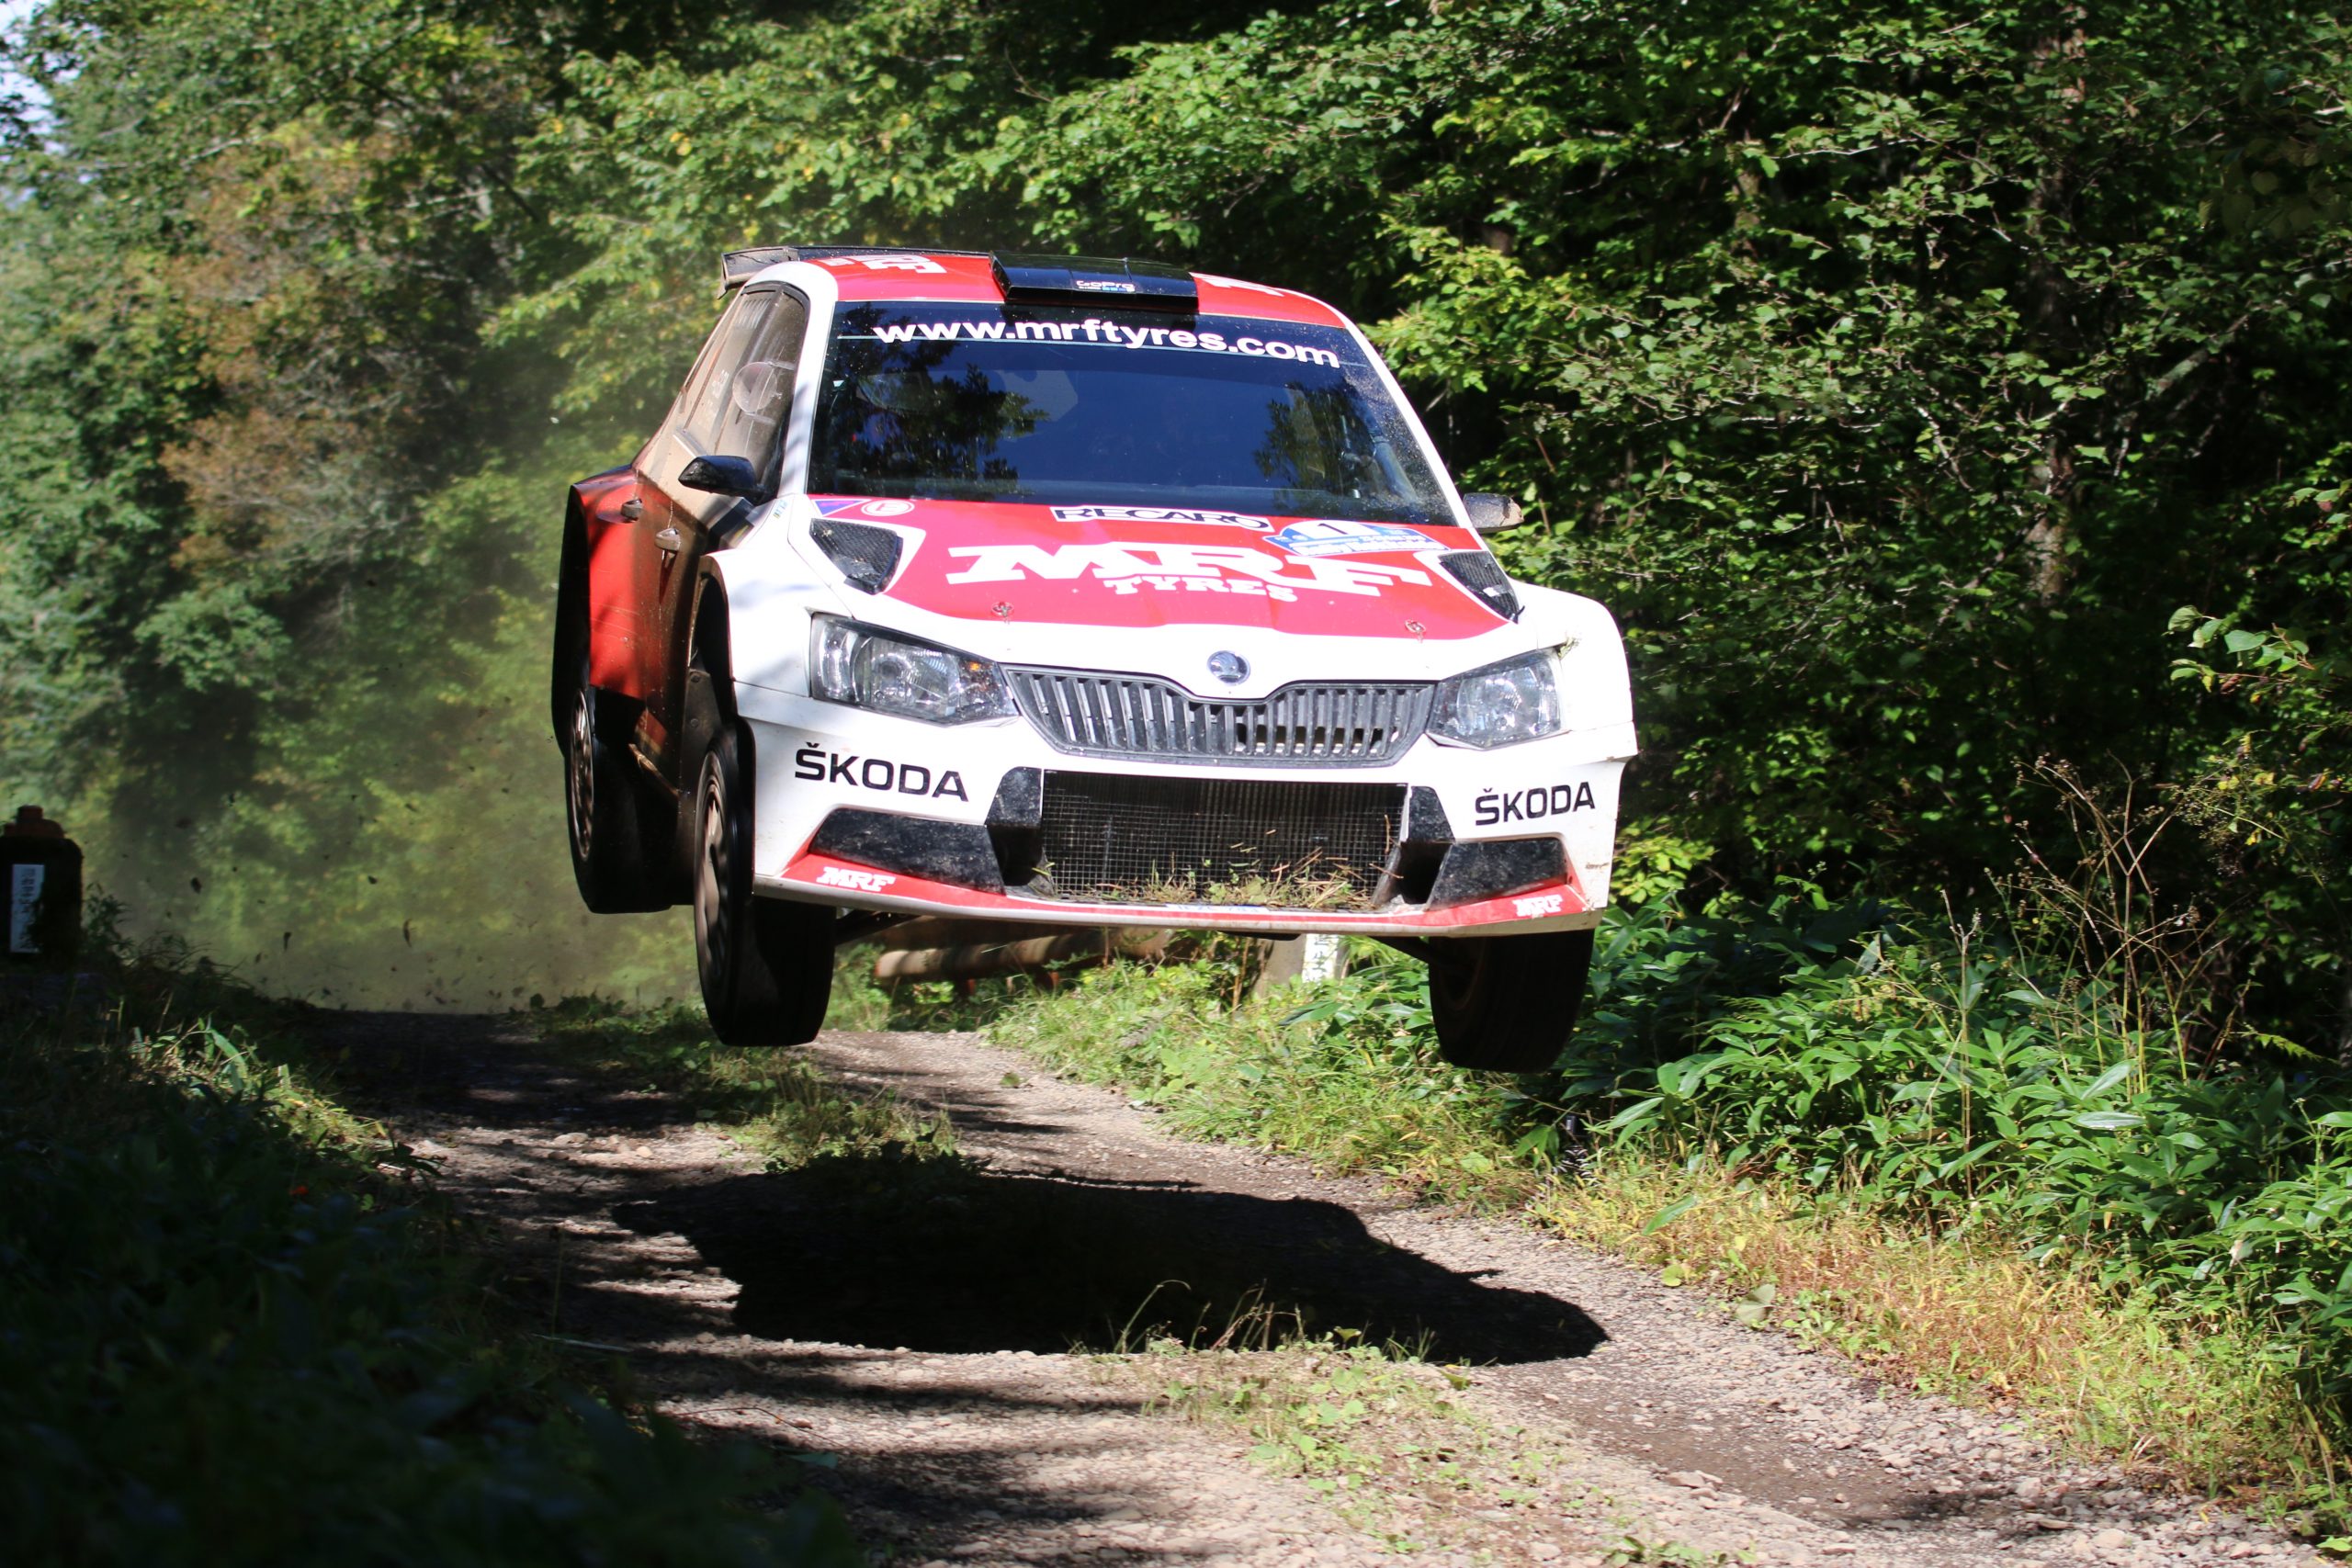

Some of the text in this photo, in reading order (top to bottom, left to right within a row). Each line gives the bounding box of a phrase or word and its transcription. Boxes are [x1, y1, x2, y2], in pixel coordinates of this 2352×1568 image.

[873, 318, 1340, 368] www.mrftyres.com
[1055, 508, 1270, 529] RECARO
[1317, 523, 1349, 535] 1
[945, 541, 1433, 597] MRF
[1103, 576, 1298, 603] TYRES
[795, 741, 969, 803] ŠKODA
[1475, 781, 1596, 826] ŠKODA
[816, 866, 897, 892] MRF
[1512, 894, 1563, 917] MRF
